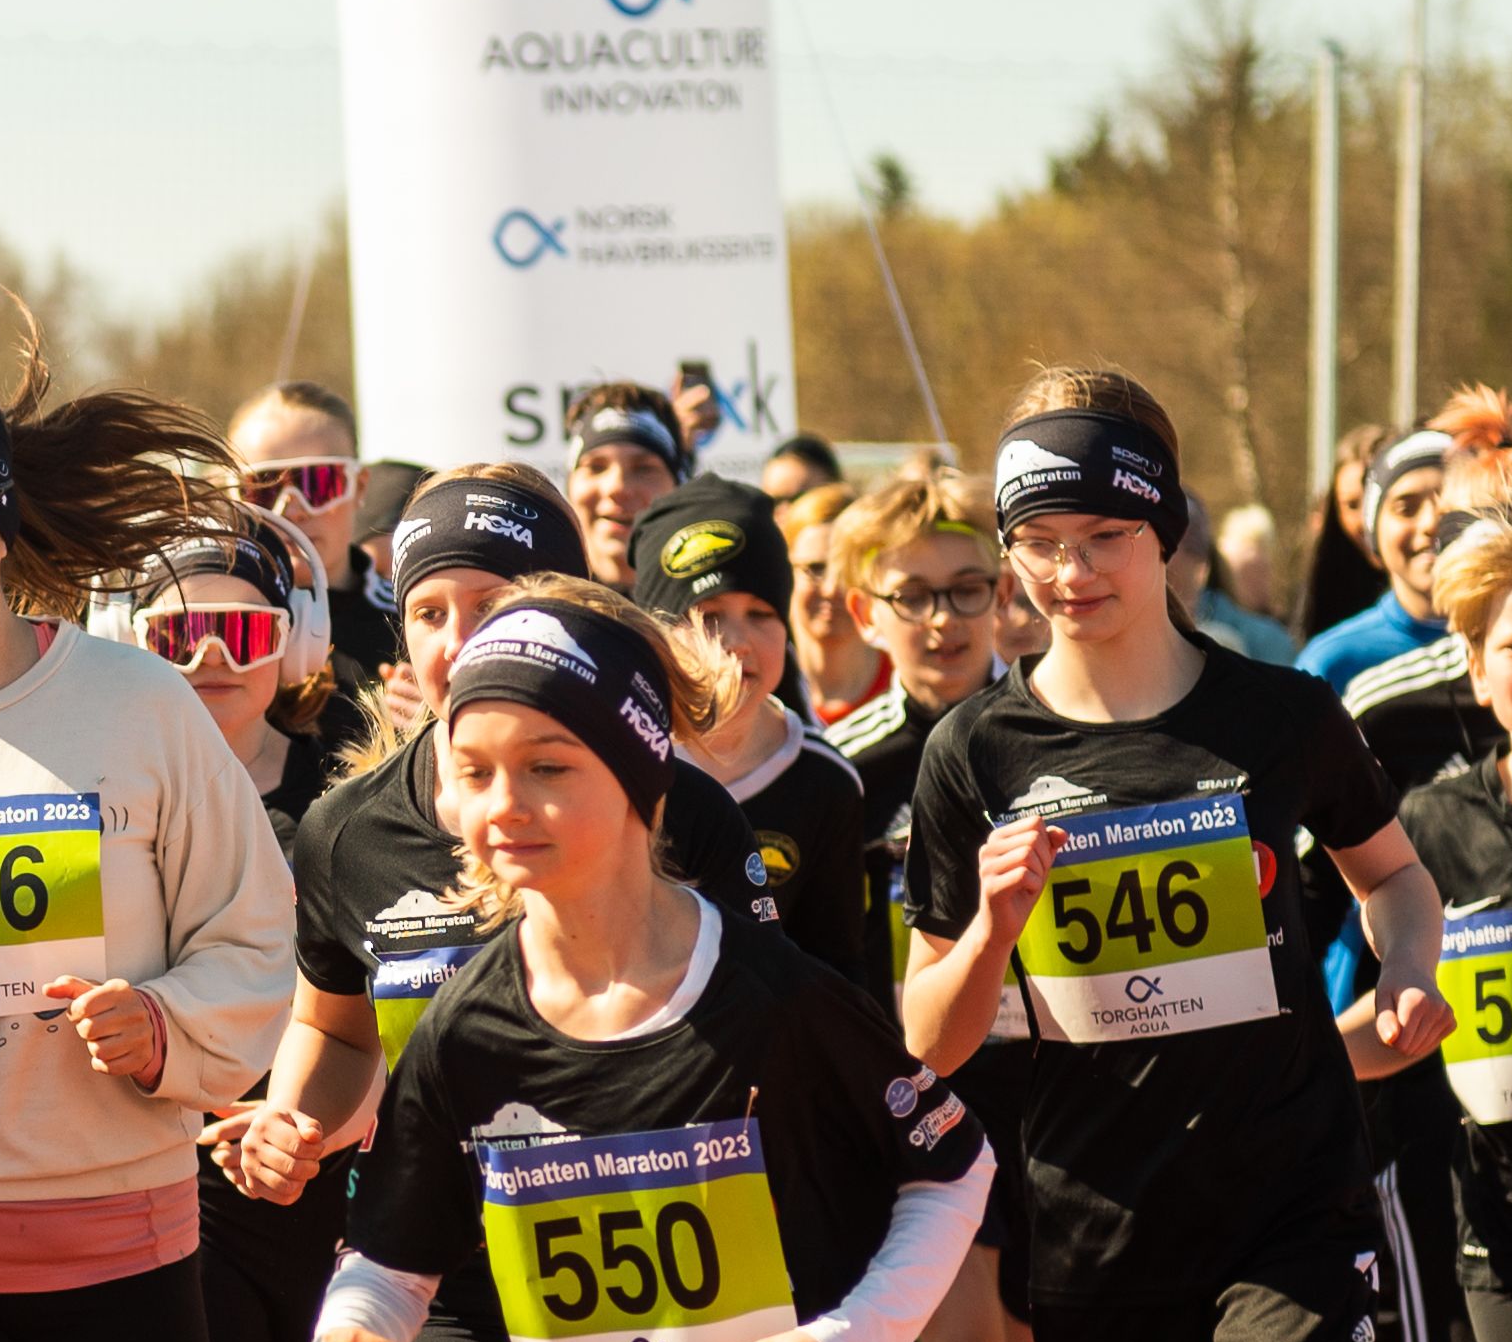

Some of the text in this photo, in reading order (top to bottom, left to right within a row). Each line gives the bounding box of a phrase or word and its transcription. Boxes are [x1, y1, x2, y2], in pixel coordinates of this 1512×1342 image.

[481, 28, 767, 73] AQUACULTURE
[542, 79, 742, 115] INNOVATION
[1022, 469, 1081, 488] Maraton
[464, 512, 533, 550] HOKA
[525, 642, 597, 686] Maraton
[620, 697, 672, 761] HOKA
[43, 802, 90, 822] 2023
[1060, 793, 1108, 811] Maraton
[1106, 816, 1186, 845] Maraton
[1190, 807, 1237, 831] 2023
[365, 914, 475, 935] Torghatten Maraton
[1052, 860, 1210, 965] 546
[1091, 997, 1204, 1026] TORGHATTEN
[1130, 1020, 1170, 1036] AQUA
[593, 1150, 689, 1178] Maraton
[693, 1134, 752, 1167] 2023
[534, 1200, 720, 1323] 550
